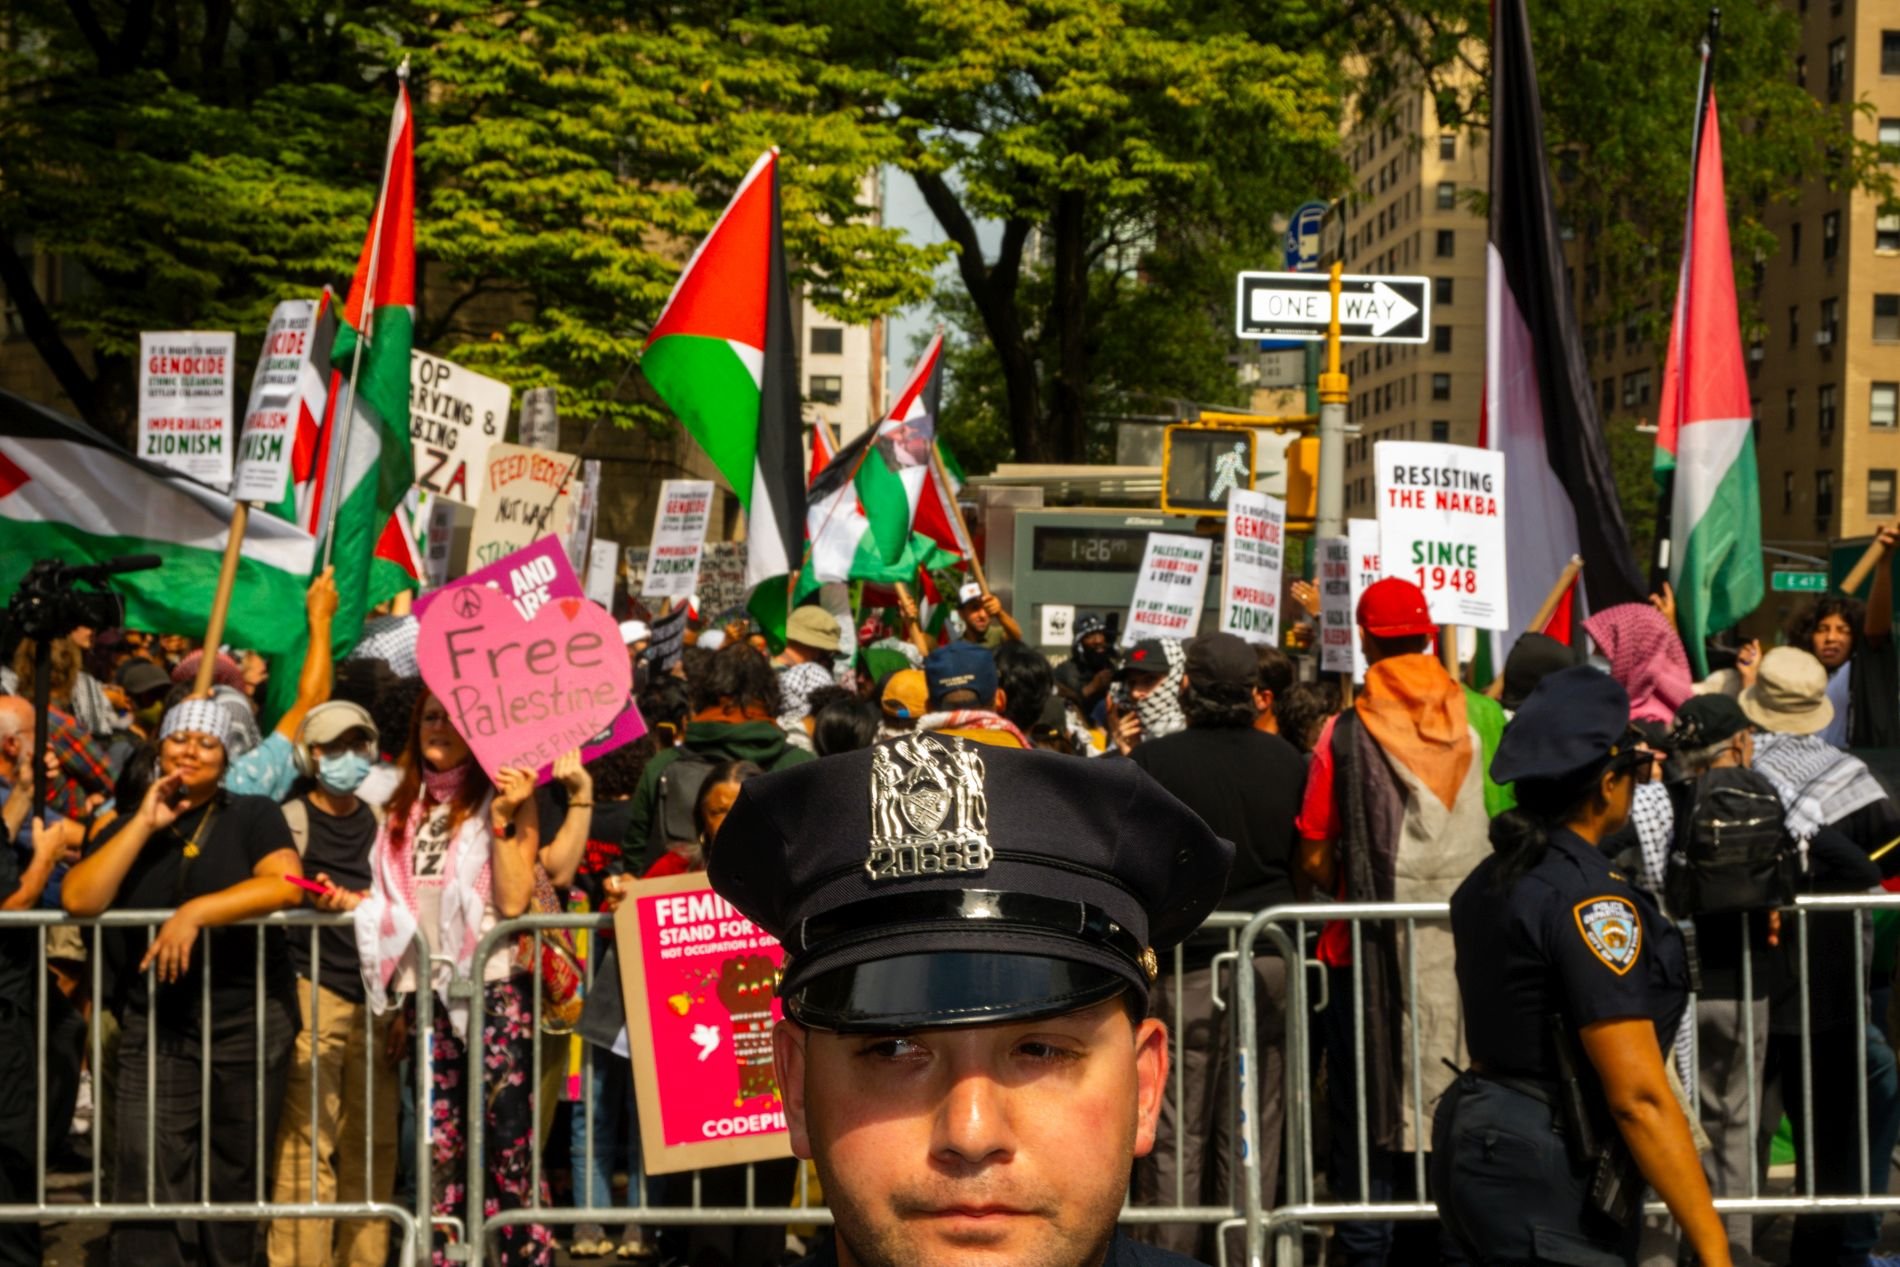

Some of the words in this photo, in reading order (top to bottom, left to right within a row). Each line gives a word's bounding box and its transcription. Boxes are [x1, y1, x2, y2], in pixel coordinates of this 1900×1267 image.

[1268, 295, 1318, 319] ONE
[1345, 298, 1397, 320] WAY
[149, 355, 225, 376] GENOCIDE
[147, 416, 224, 431] IMPERIALISM
[411, 414, 458, 451] BING
[483, 410, 497, 436] &
[146, 432, 223, 456] ZIONISM
[417, 448, 468, 502] ZA
[489, 453, 527, 493] FEED
[1393, 465, 1493, 494] RESISTING
[1387, 488, 1427, 510] THE
[1435, 490, 1499, 517] NAKBA
[1234, 514, 1281, 546] GENOCIDE
[1071, 539, 1111, 562] 1:26
[1152, 545, 1204, 561] PALESTINIAN
[1411, 540, 1478, 569] SINCE
[510, 555, 557, 599] AND
[652, 558, 696, 575] ZIONISM
[1150, 558, 1199, 575] LIBERATION
[1158, 571, 1193, 587] RETURN
[1415, 566, 1477, 594] 1948
[1135, 611, 1188, 630] NECESSARY
[1166, 602, 1194, 617] MEANS
[1229, 603, 1275, 637] ZIONISM
[445, 624, 604, 680] Free
[449, 676, 619, 740] Palestine
[868, 839, 986, 878] 20668
[658, 923, 716, 947] STAND
[718, 918, 755, 939] FOR
[661, 946, 682, 960] NOT
[683, 939, 748, 957] OCCUPATION
[748, 937, 758, 949] &
